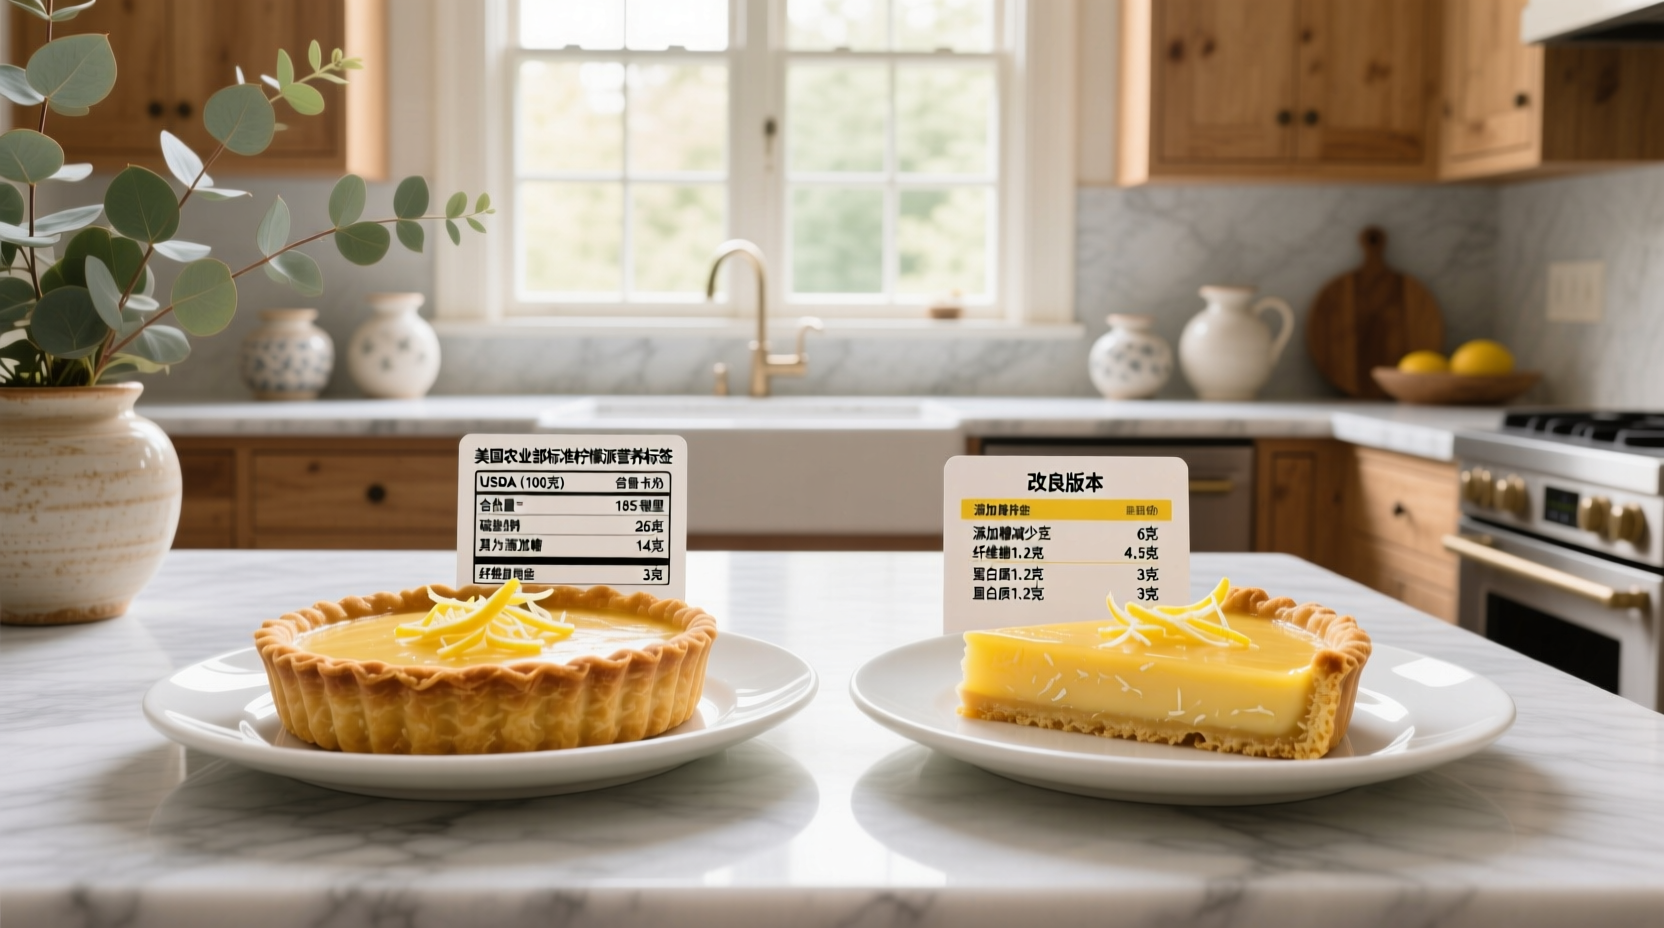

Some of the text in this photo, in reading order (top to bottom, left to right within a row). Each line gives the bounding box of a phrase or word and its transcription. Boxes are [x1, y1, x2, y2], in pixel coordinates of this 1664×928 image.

[480, 476, 565, 490] USDA (100克)
[1027, 472, 1104, 493] 改良版本
[1137, 525, 1159, 541] 6克
[636, 537, 664, 553] 14克
[1124, 546, 1159, 560] 4.5克
[643, 566, 663, 581] 3克
[1137, 567, 1159, 582] 3克
[1137, 586, 1159, 601] 3克
